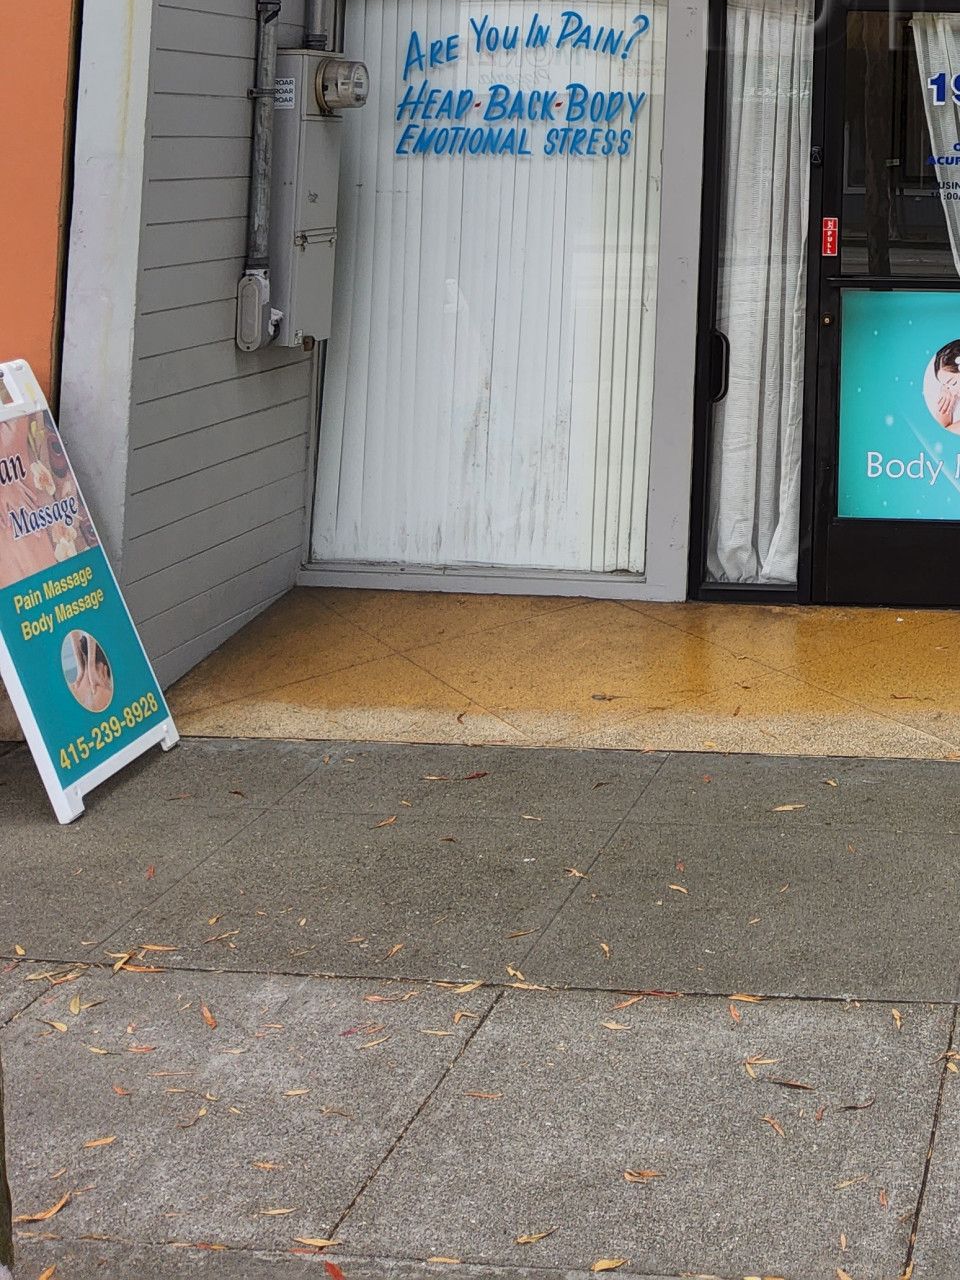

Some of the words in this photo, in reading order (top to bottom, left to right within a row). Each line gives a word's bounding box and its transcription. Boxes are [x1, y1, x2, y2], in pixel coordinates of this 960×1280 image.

[403, 31, 459, 80] ARE
[556, 11, 650, 59] PAIN?
[396, 124, 531, 155] EMOTIONAL
[544, 128, 631, 155] STRESS
[866, 451, 944, 485] Body
[9, 496, 78, 539] Massage
[14, 590, 42, 614] Pain
[43, 566, 93, 601] Massage
[21, 612, 54, 641] Body
[54, 588, 104, 624] Massage
[59, 692, 158, 769] 415-239-8928
